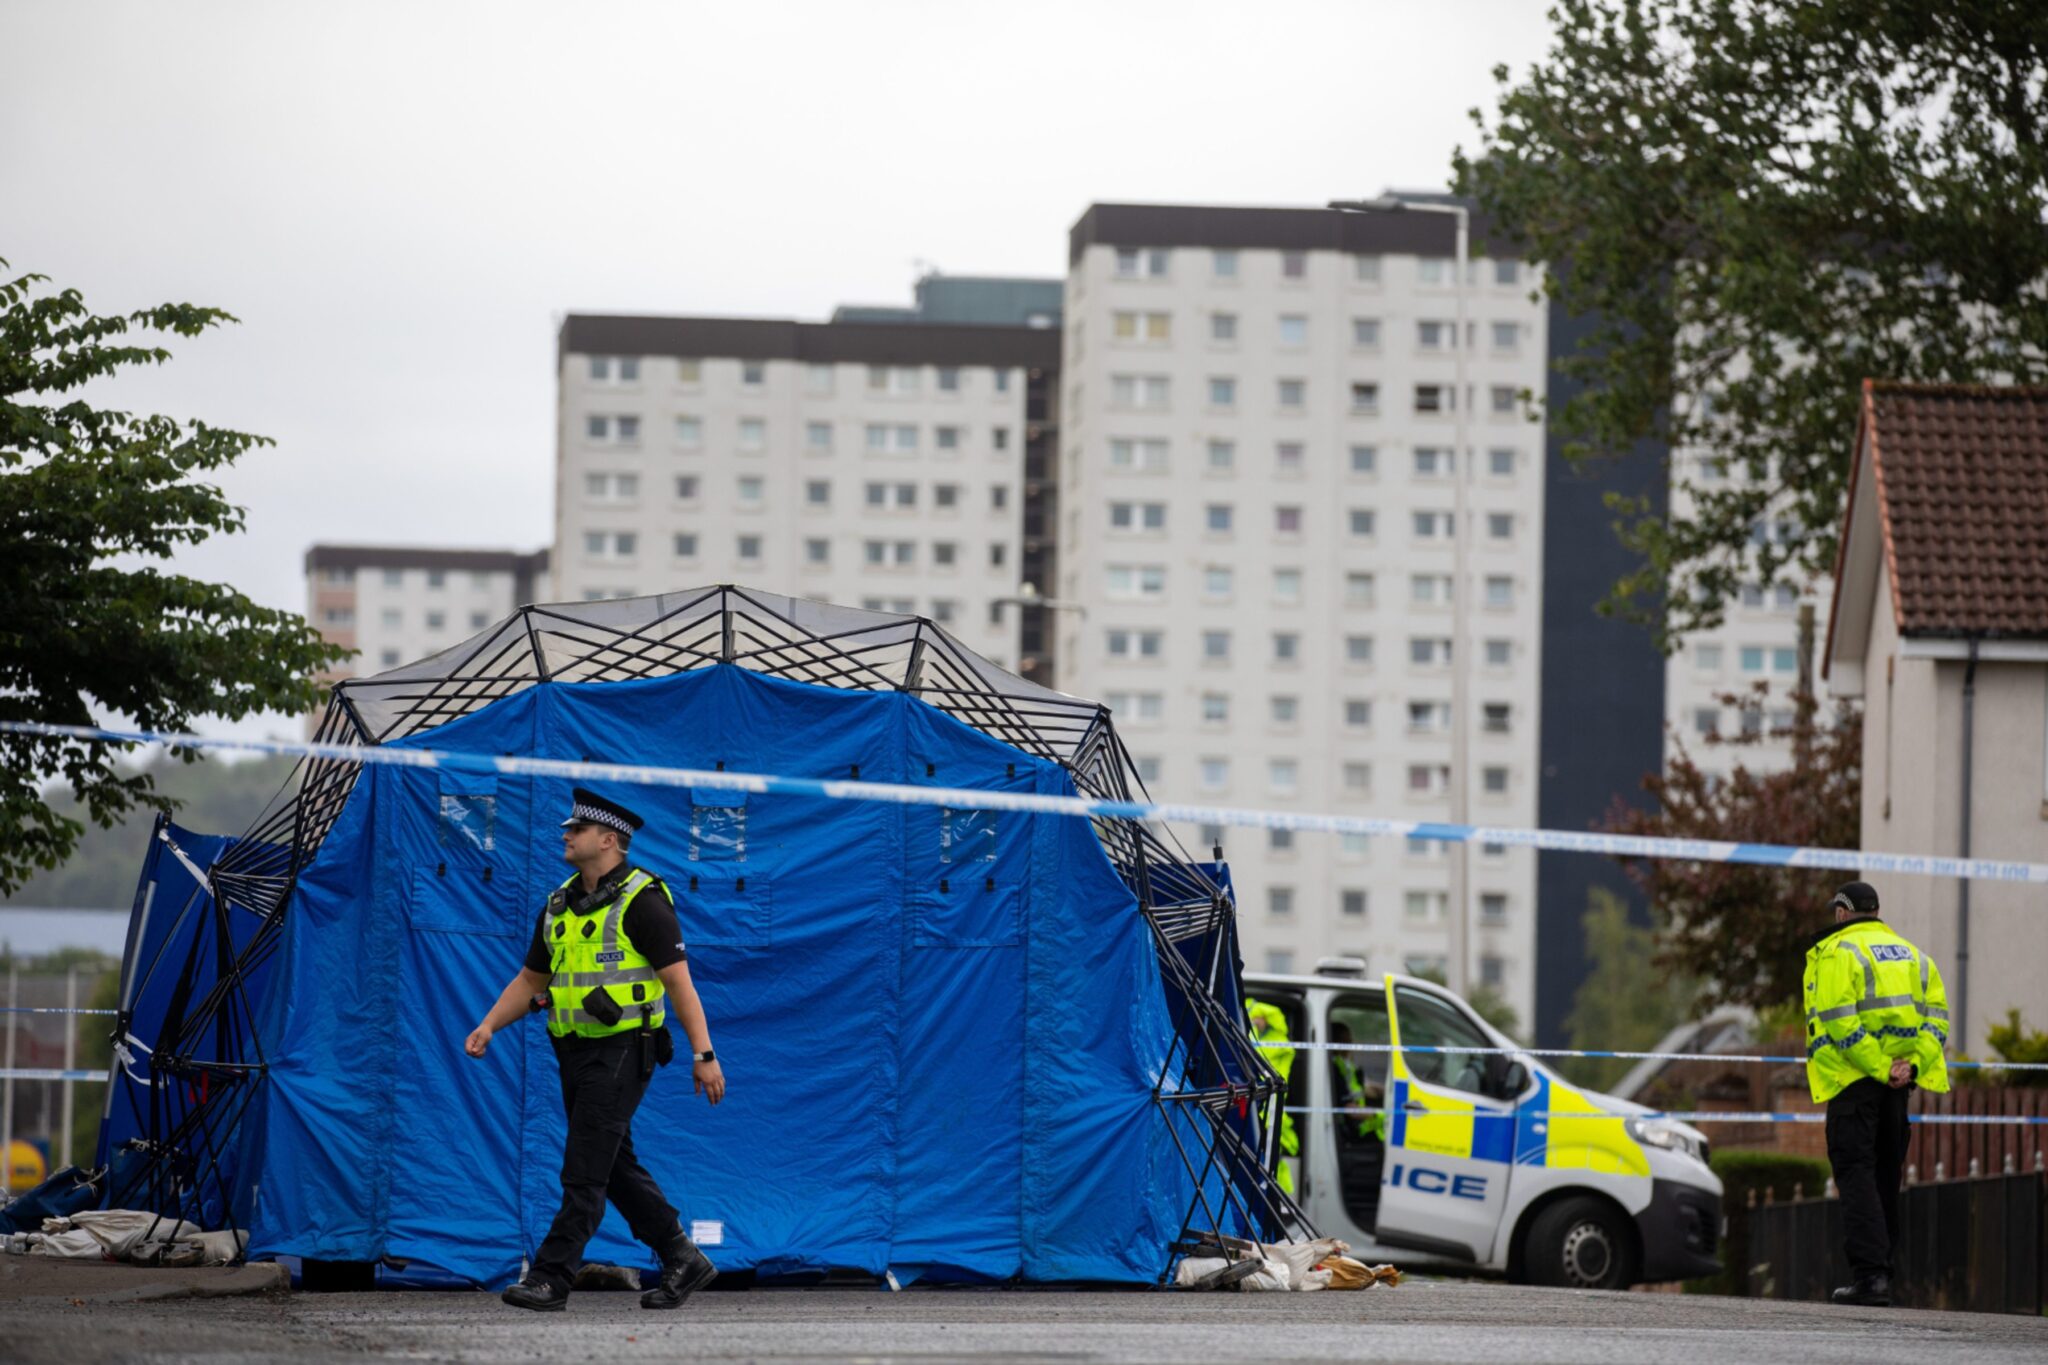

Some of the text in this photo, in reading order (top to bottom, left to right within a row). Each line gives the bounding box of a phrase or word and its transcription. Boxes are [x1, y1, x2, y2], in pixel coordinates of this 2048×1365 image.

[598, 952, 623, 962] POLICE
[1872, 946, 1912, 960] POLIC
[1382, 1164, 1488, 1201] ICE
